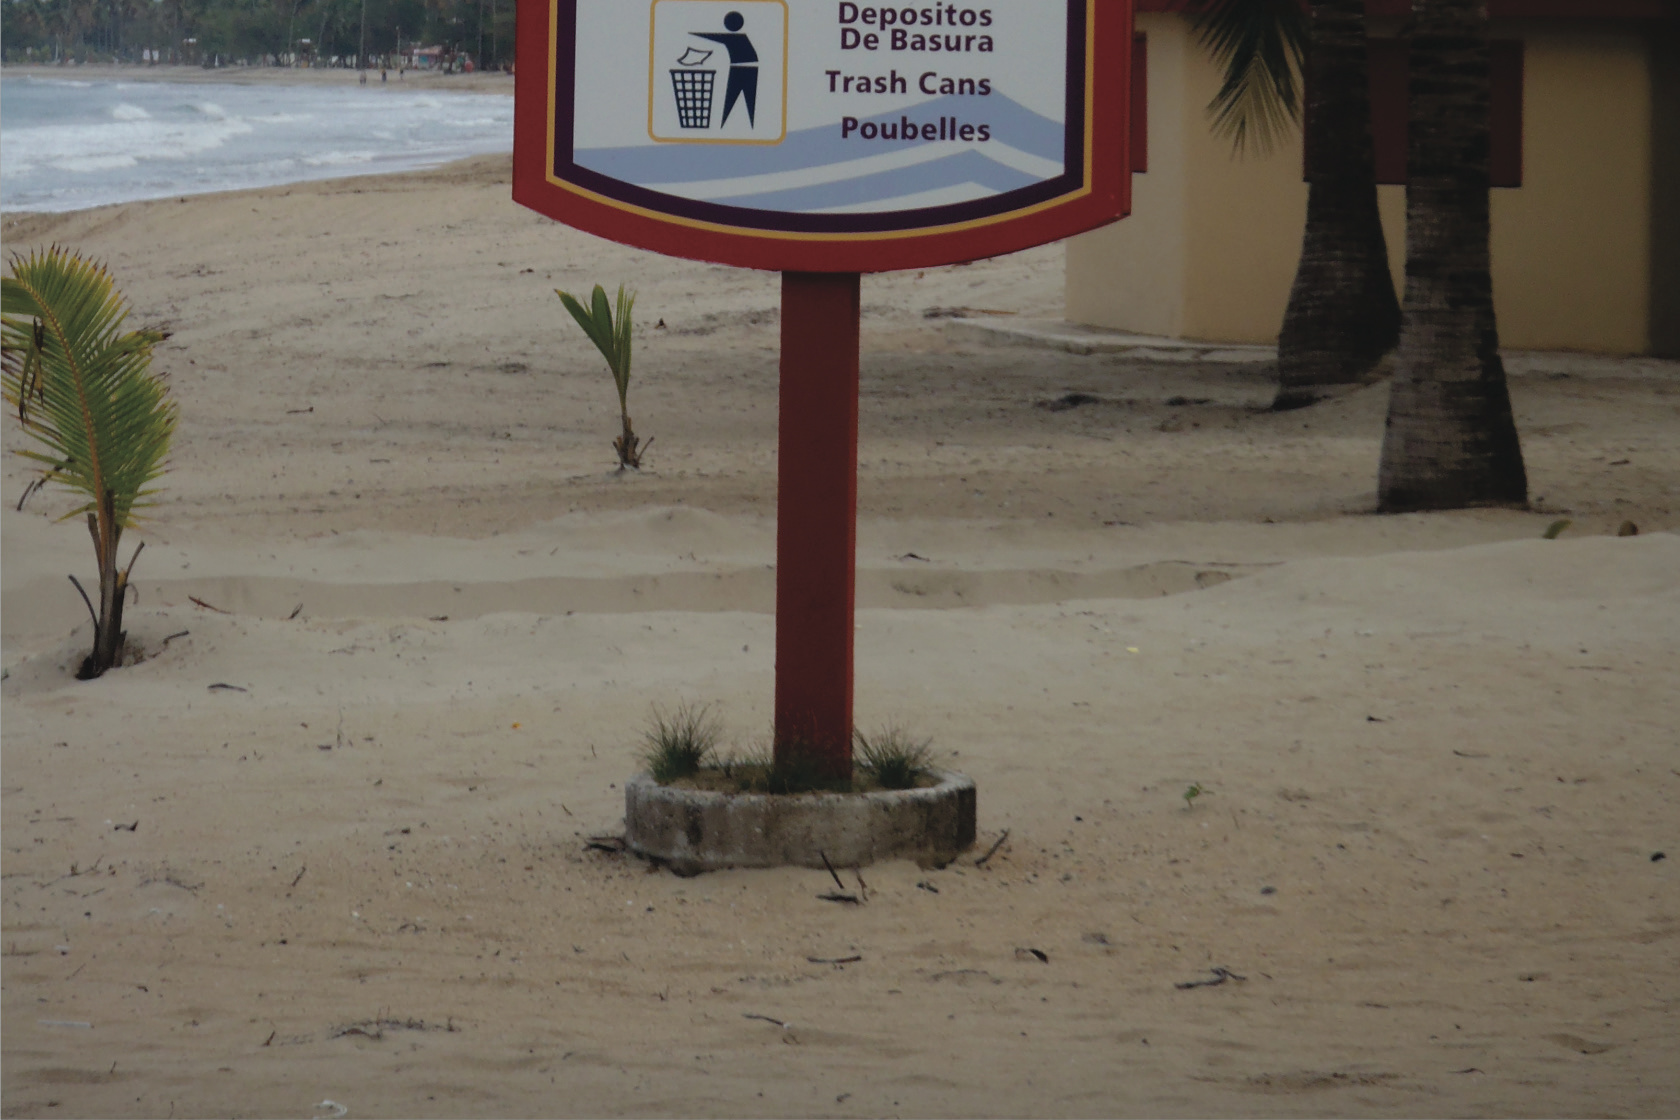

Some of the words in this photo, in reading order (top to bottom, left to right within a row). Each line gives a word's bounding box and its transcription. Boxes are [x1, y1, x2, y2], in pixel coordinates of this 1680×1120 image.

[838, 1, 993, 31] Depositos
[840, 27, 879, 51] De
[890, 28, 994, 53] Basura
[825, 70, 907, 95] Trash
[918, 71, 992, 96] Cans
[841, 116, 991, 142] Poubelles
